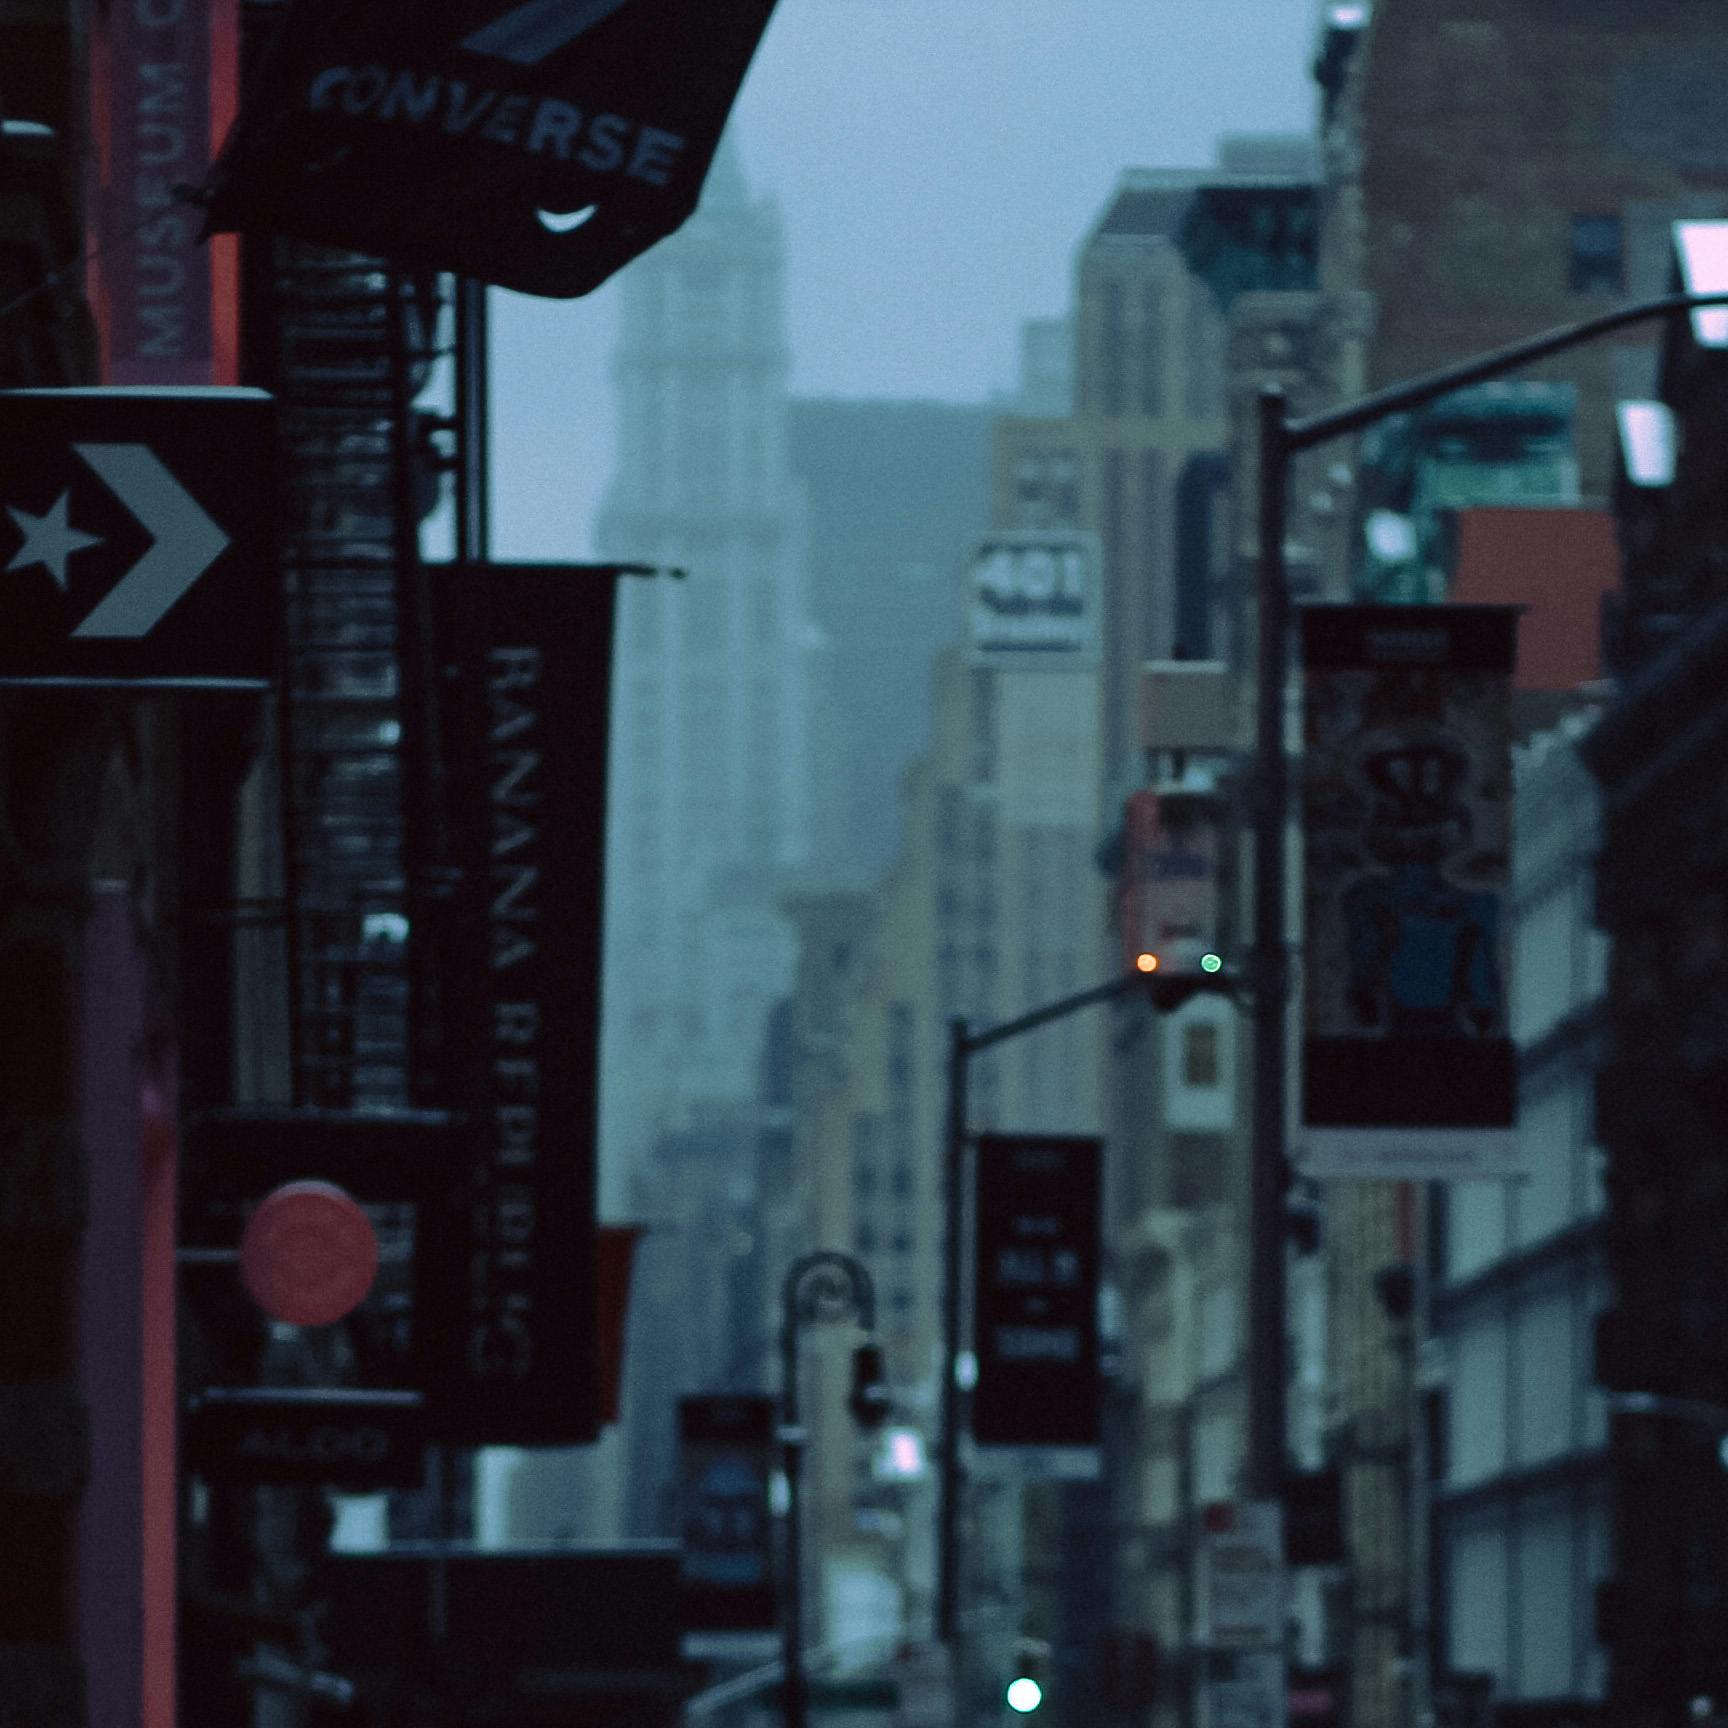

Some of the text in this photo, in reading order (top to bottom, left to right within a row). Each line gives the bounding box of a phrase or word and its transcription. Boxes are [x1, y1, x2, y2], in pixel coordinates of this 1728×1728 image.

[134, 61, 188, 357] MUSEUM
[309, 64, 686, 187] CONVERSE
[486, 645, 543, 971] BANANA
